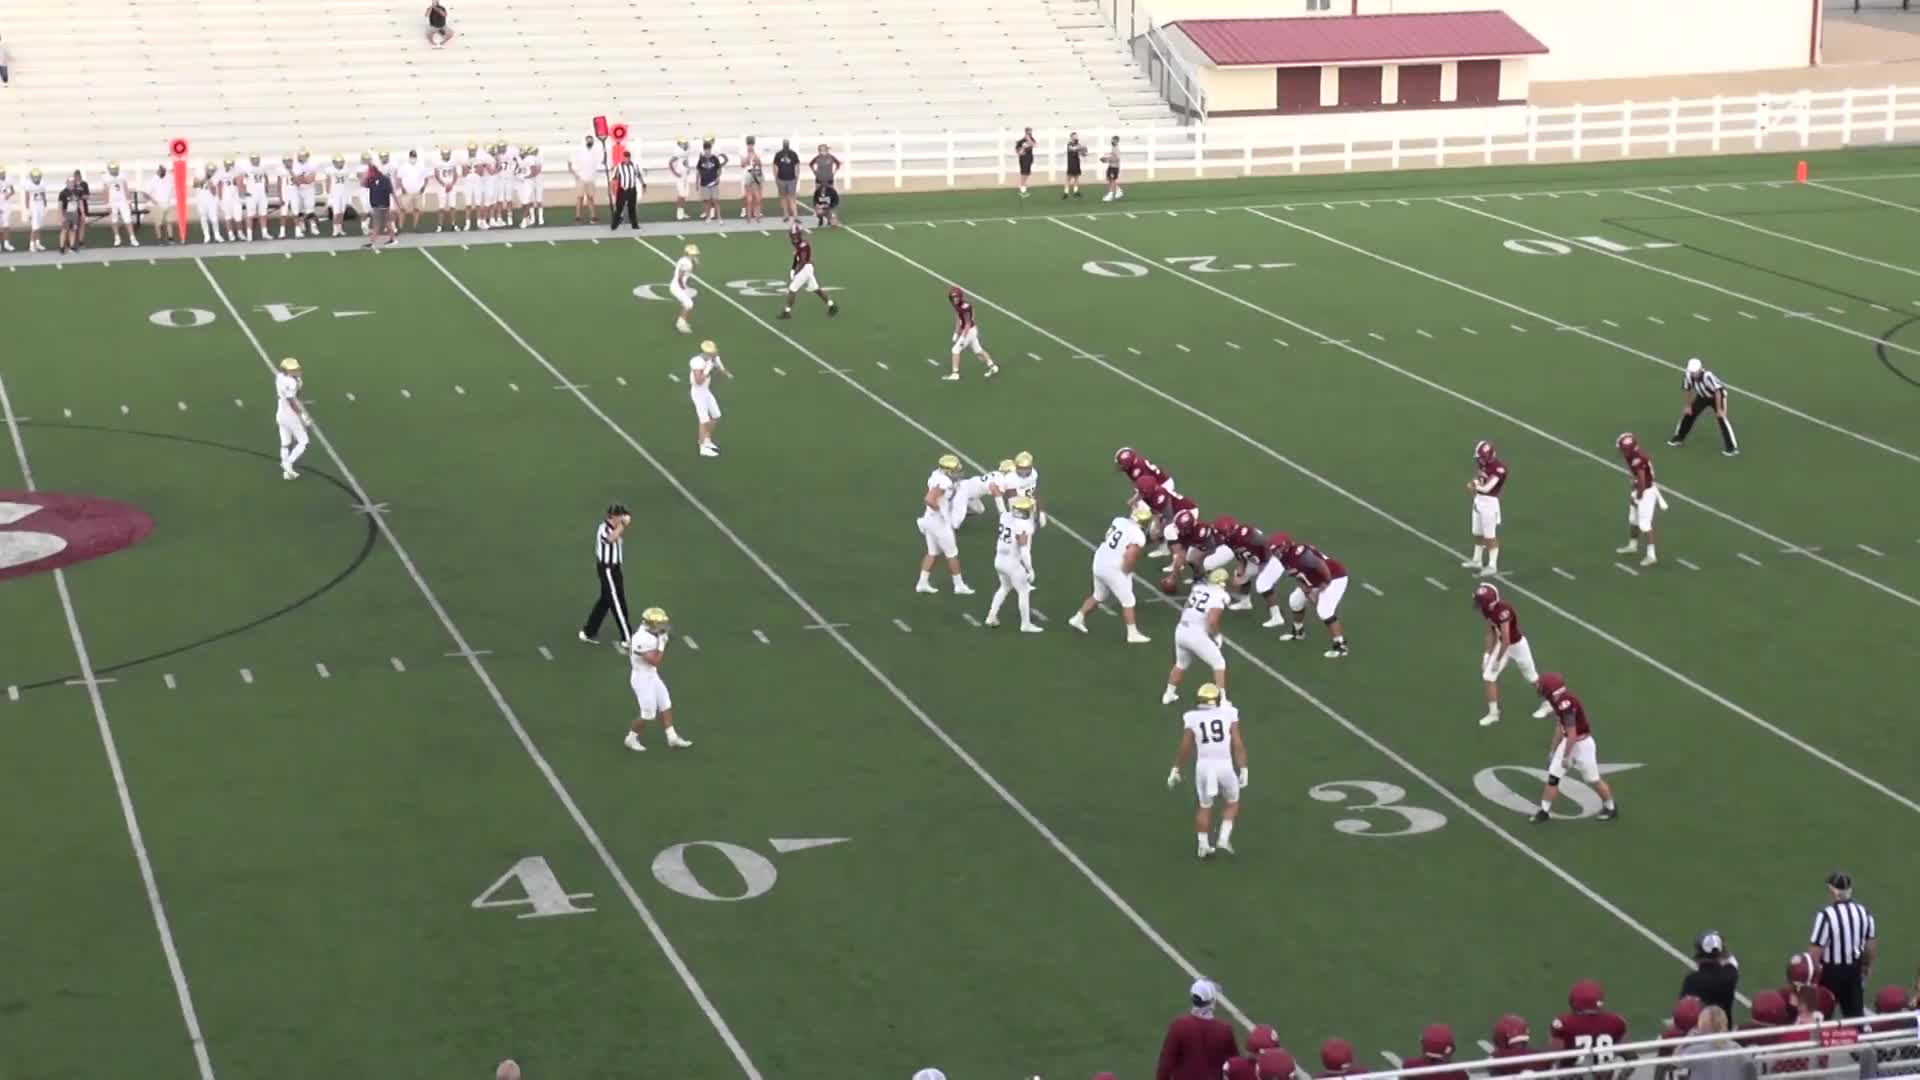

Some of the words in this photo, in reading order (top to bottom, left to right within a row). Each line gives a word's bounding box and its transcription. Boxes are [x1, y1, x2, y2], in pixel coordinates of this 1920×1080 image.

[1503, 236, 1641, 255] 10
[1082, 256, 1253, 278] 20
[149, 303, 319, 328] 40
[1199, 719, 1225, 744] 19
[1309, 764, 1606, 837] 30
[471, 840, 777, 919] 40
